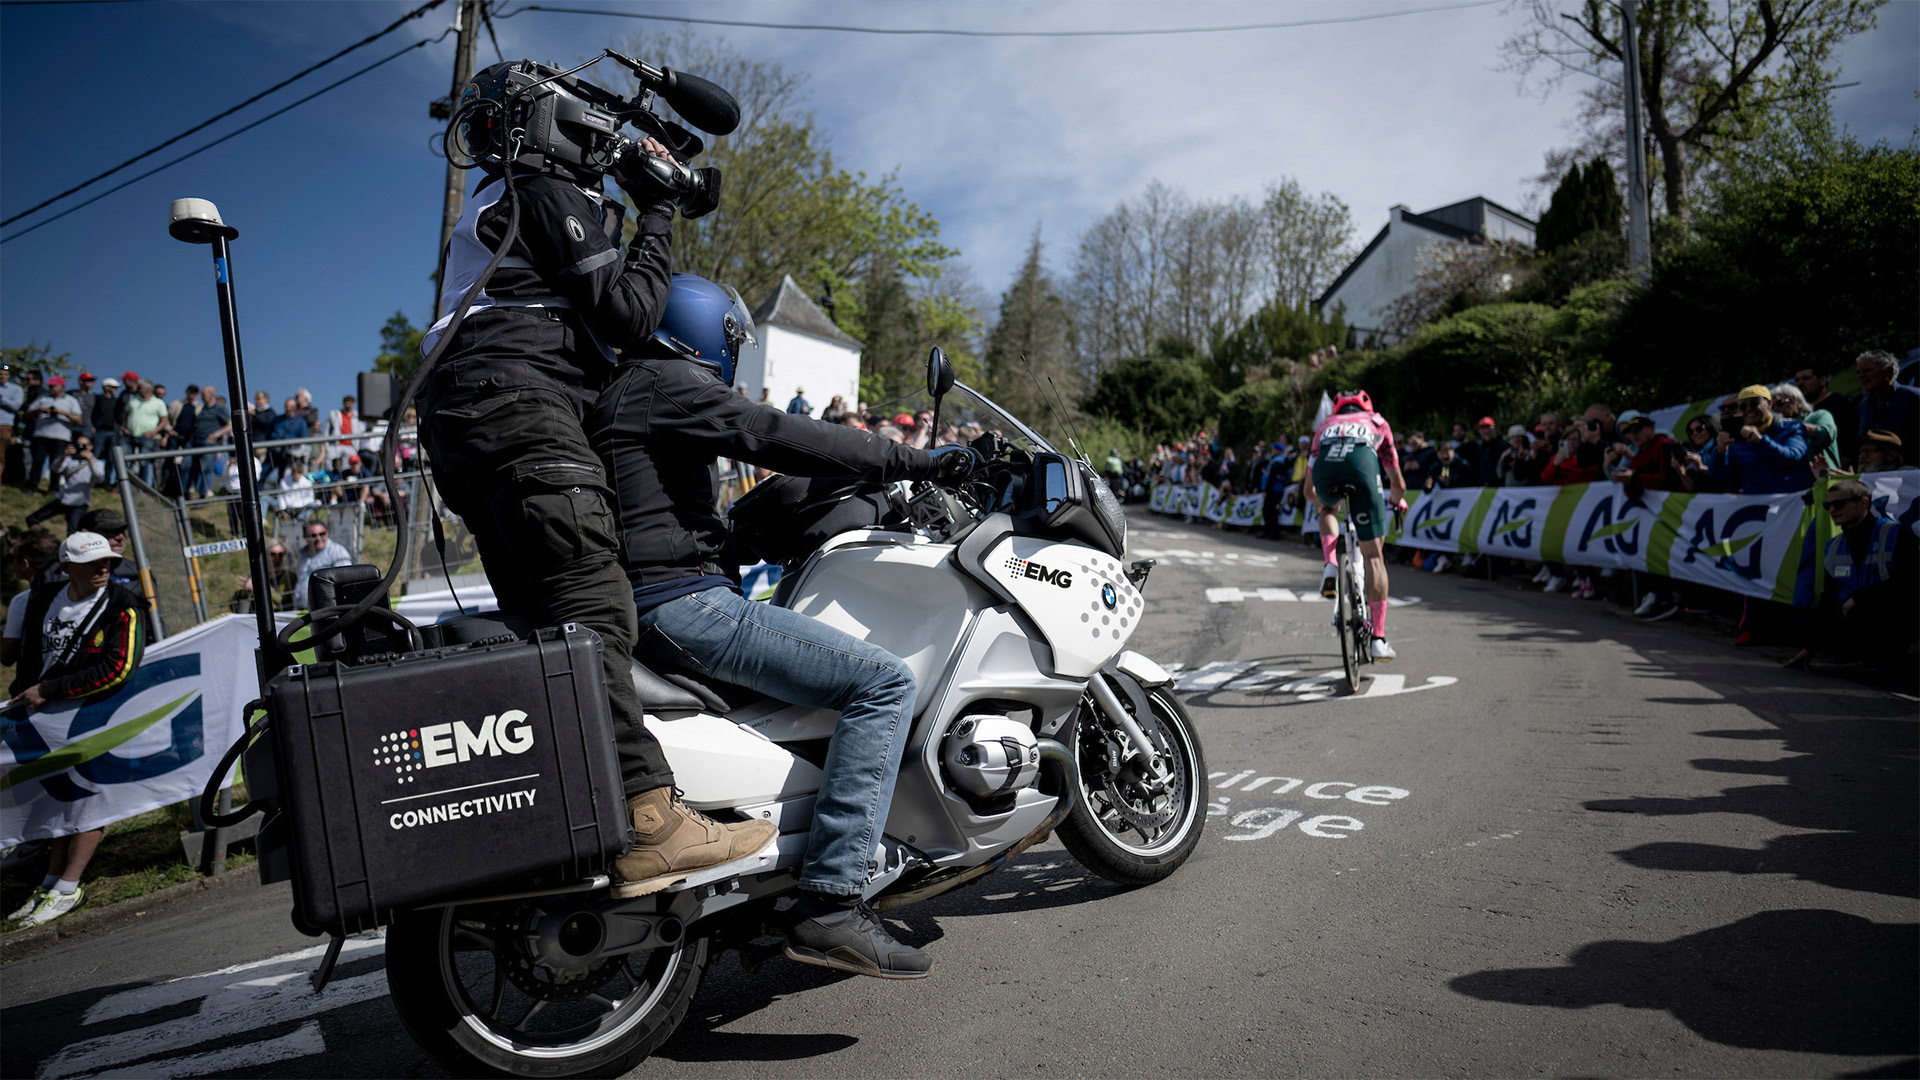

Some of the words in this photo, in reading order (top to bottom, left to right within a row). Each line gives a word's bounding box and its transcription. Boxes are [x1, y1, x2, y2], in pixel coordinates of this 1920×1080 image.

[1412, 499, 1461, 540] AG
[1487, 498, 1536, 548] AG
[1578, 496, 1646, 555] AG
[190, 541, 238, 557] HERAS
[1024, 561, 1072, 588] EMG
[420, 709, 534, 768] EMG
[389, 788, 536, 830] CONNECTIVITY
